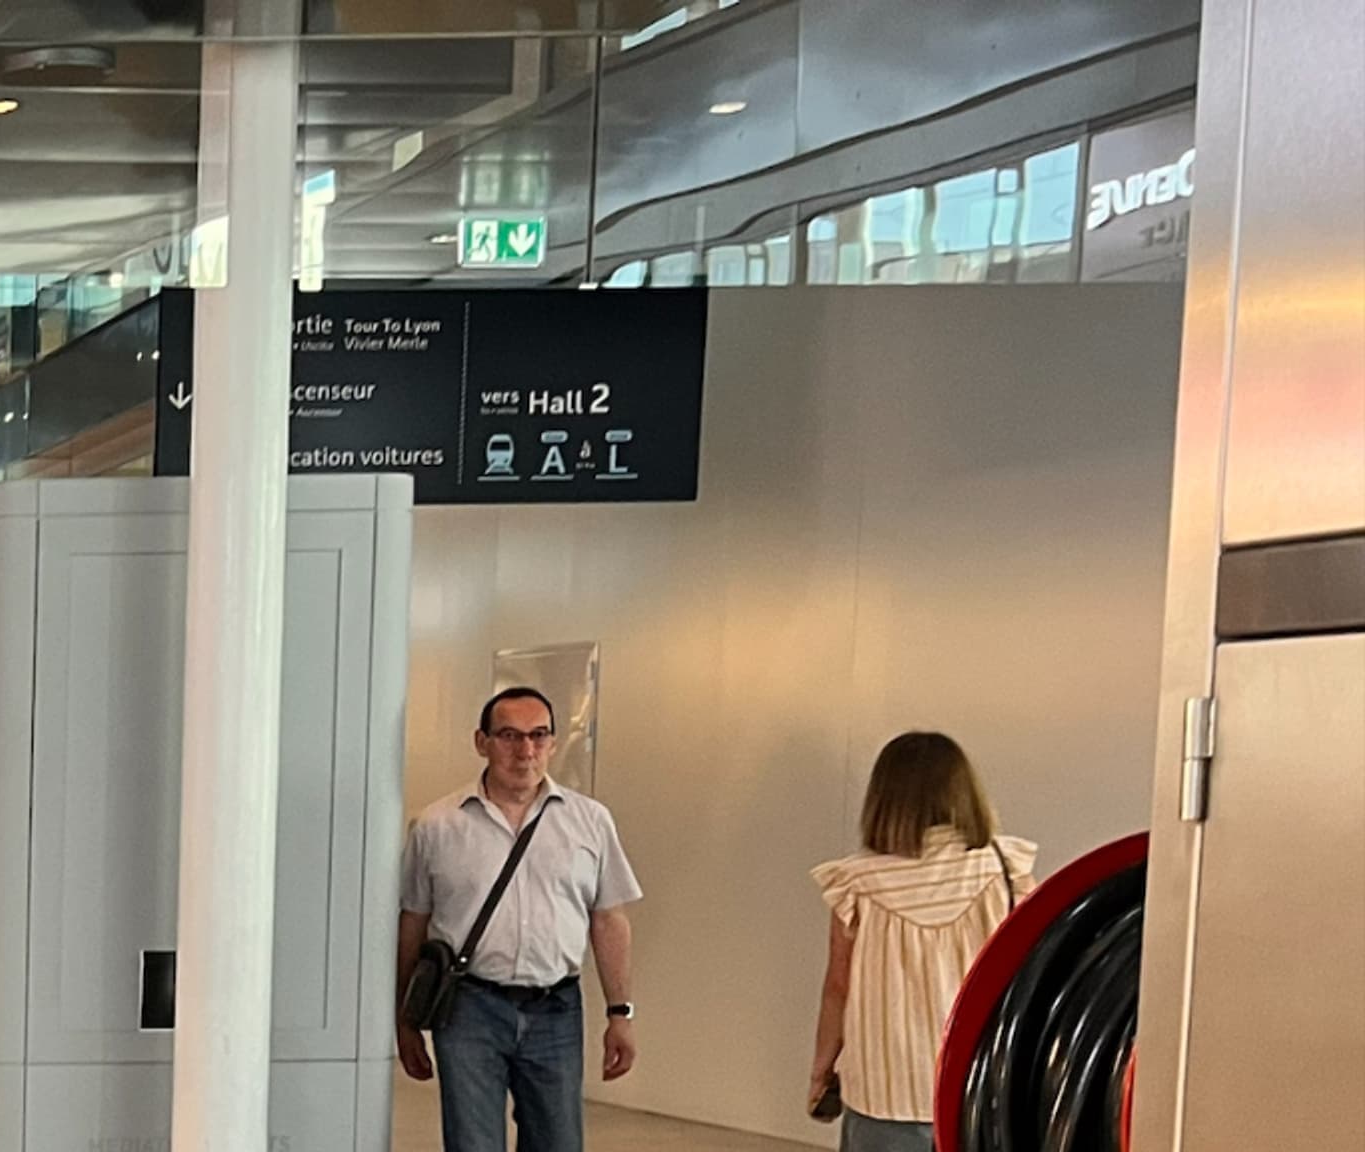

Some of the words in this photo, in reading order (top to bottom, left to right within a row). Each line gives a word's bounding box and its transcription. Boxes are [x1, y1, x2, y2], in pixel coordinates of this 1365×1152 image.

[291, 315, 333, 335] rtie
[344, 318, 378, 334] Tour
[382, 318, 401, 333] To
[404, 318, 441, 335] Lyon
[344, 336, 384, 350] Vivier
[387, 336, 429, 351] Merle
[292, 384, 376, 401] censeur
[481, 390, 520, 404] vers
[528, 389, 584, 415] Hall
[589, 382, 611, 414] 2
[290, 446, 355, 467] cation
[360, 446, 444, 466] voitures
[540, 445, 567, 475] A
[608, 444, 629, 474] L
